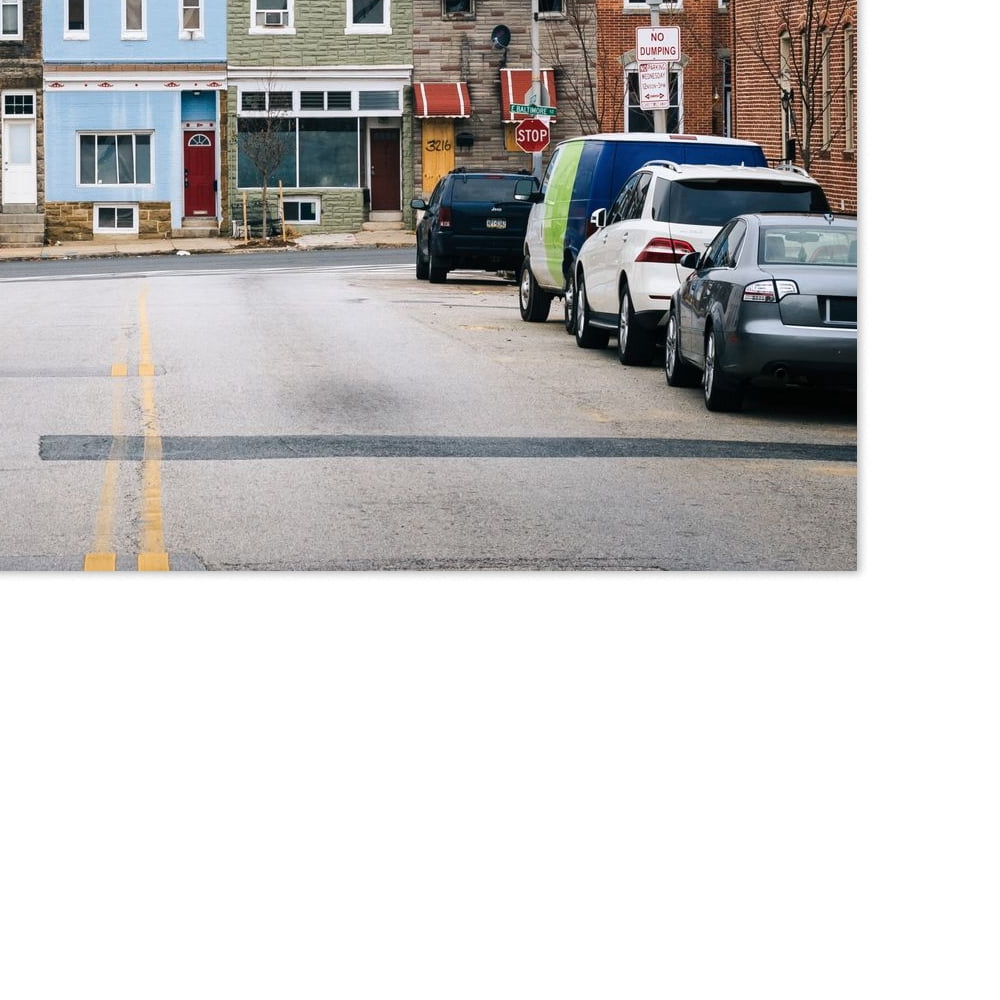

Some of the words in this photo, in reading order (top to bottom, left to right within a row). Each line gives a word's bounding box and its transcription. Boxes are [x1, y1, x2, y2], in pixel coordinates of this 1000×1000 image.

[651, 32, 665, 42] NO
[640, 46, 676, 56] DUMPING
[516, 105, 546, 114] BALTIMORE
[517, 129, 548, 142] STOP
[426, 140, 451, 152] 3216
